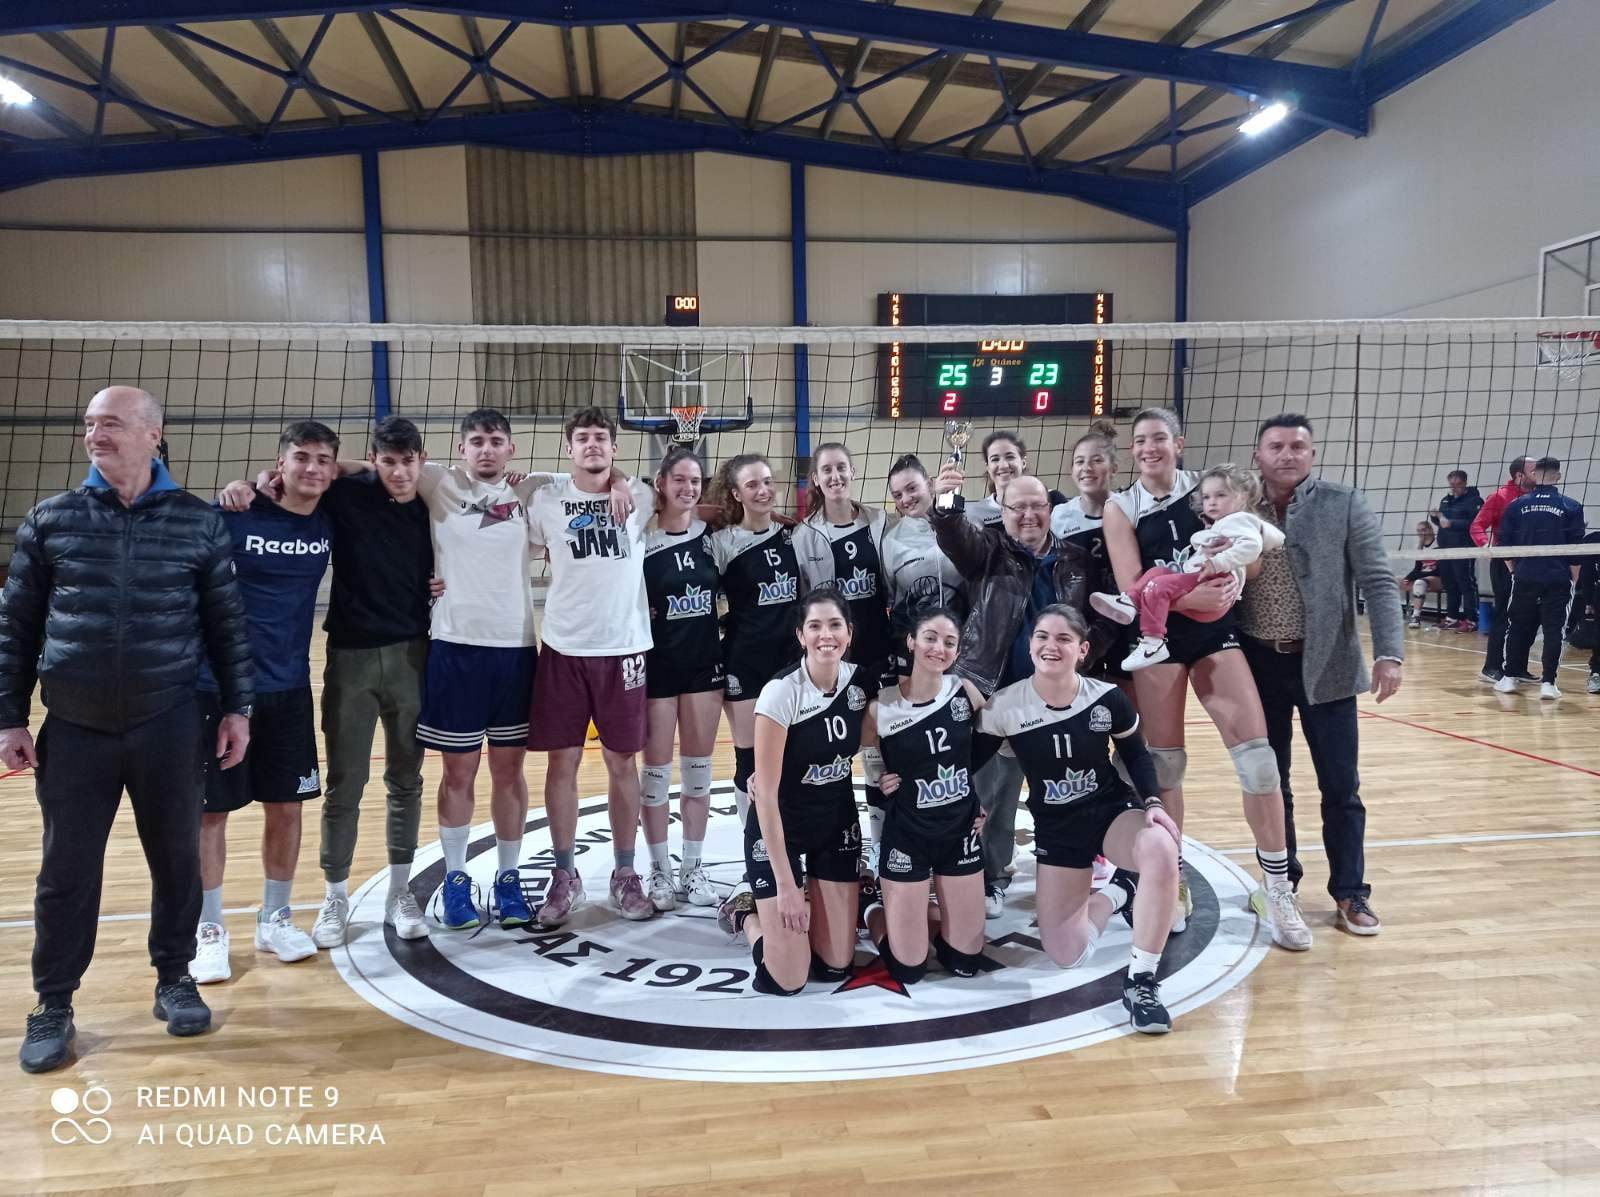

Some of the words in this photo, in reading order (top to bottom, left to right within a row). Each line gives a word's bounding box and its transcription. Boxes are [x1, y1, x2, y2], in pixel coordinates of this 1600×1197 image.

[939, 365, 967, 385] 25
[990, 367, 1003, 385] 3
[1030, 364, 1058, 384] 23
[944, 393, 956, 411] 2
[1036, 392, 1048, 409] 0
[246, 535, 329, 555] Reebok
[570, 528, 620, 559] JAM
[844, 541, 858, 560] 9
[674, 551, 695, 571] 14
[763, 549, 781, 567] 15
[824, 716, 847, 742] 10
[925, 727, 951, 754] 12
[1053, 734, 1072, 758] 11
[963, 829, 980, 856] 12
[601, 957, 750, 994] 192
